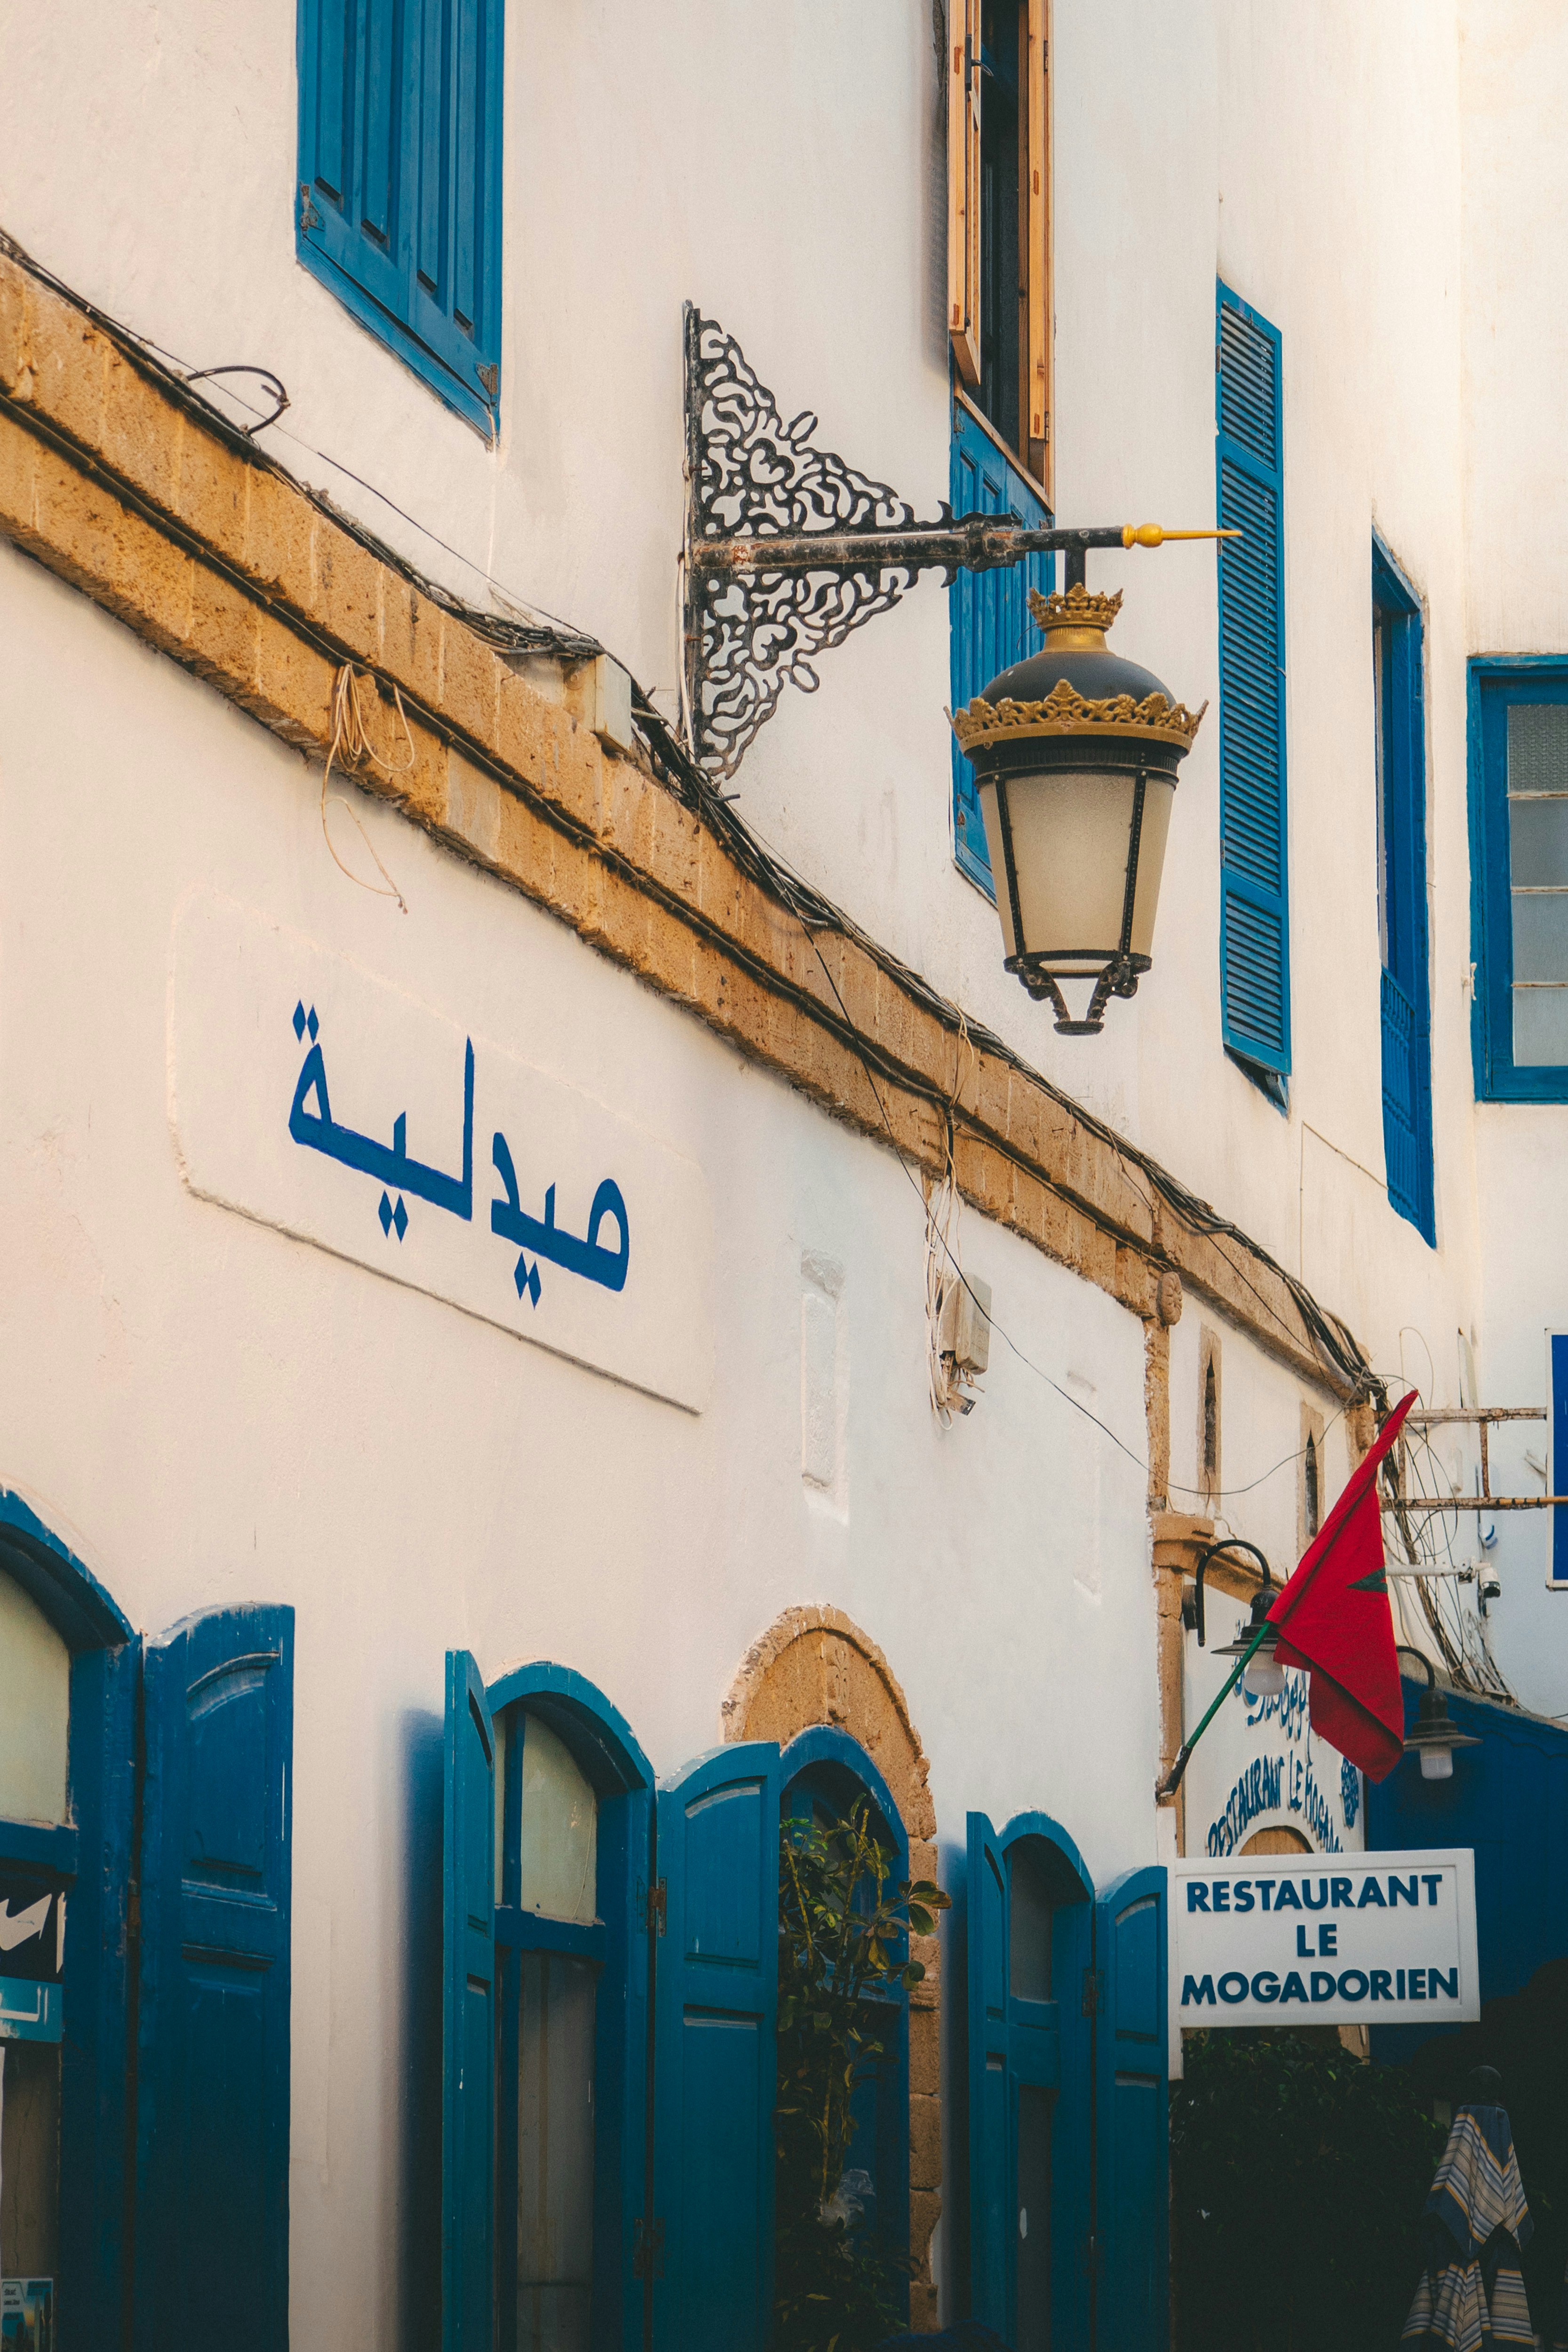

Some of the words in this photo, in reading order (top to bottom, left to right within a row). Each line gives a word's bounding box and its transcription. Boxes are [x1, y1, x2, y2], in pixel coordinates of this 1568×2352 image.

[289, 999, 629, 1309] صيدلية
[1208, 1754, 1284, 1857] RESTAURANT
[1289, 1749, 1303, 1811] LE
[1187, 1874, 1442, 1912] RESTAURANT
[1297, 1923, 1337, 1957] LE
[1181, 1967, 1458, 2005] MOGADORIEN
